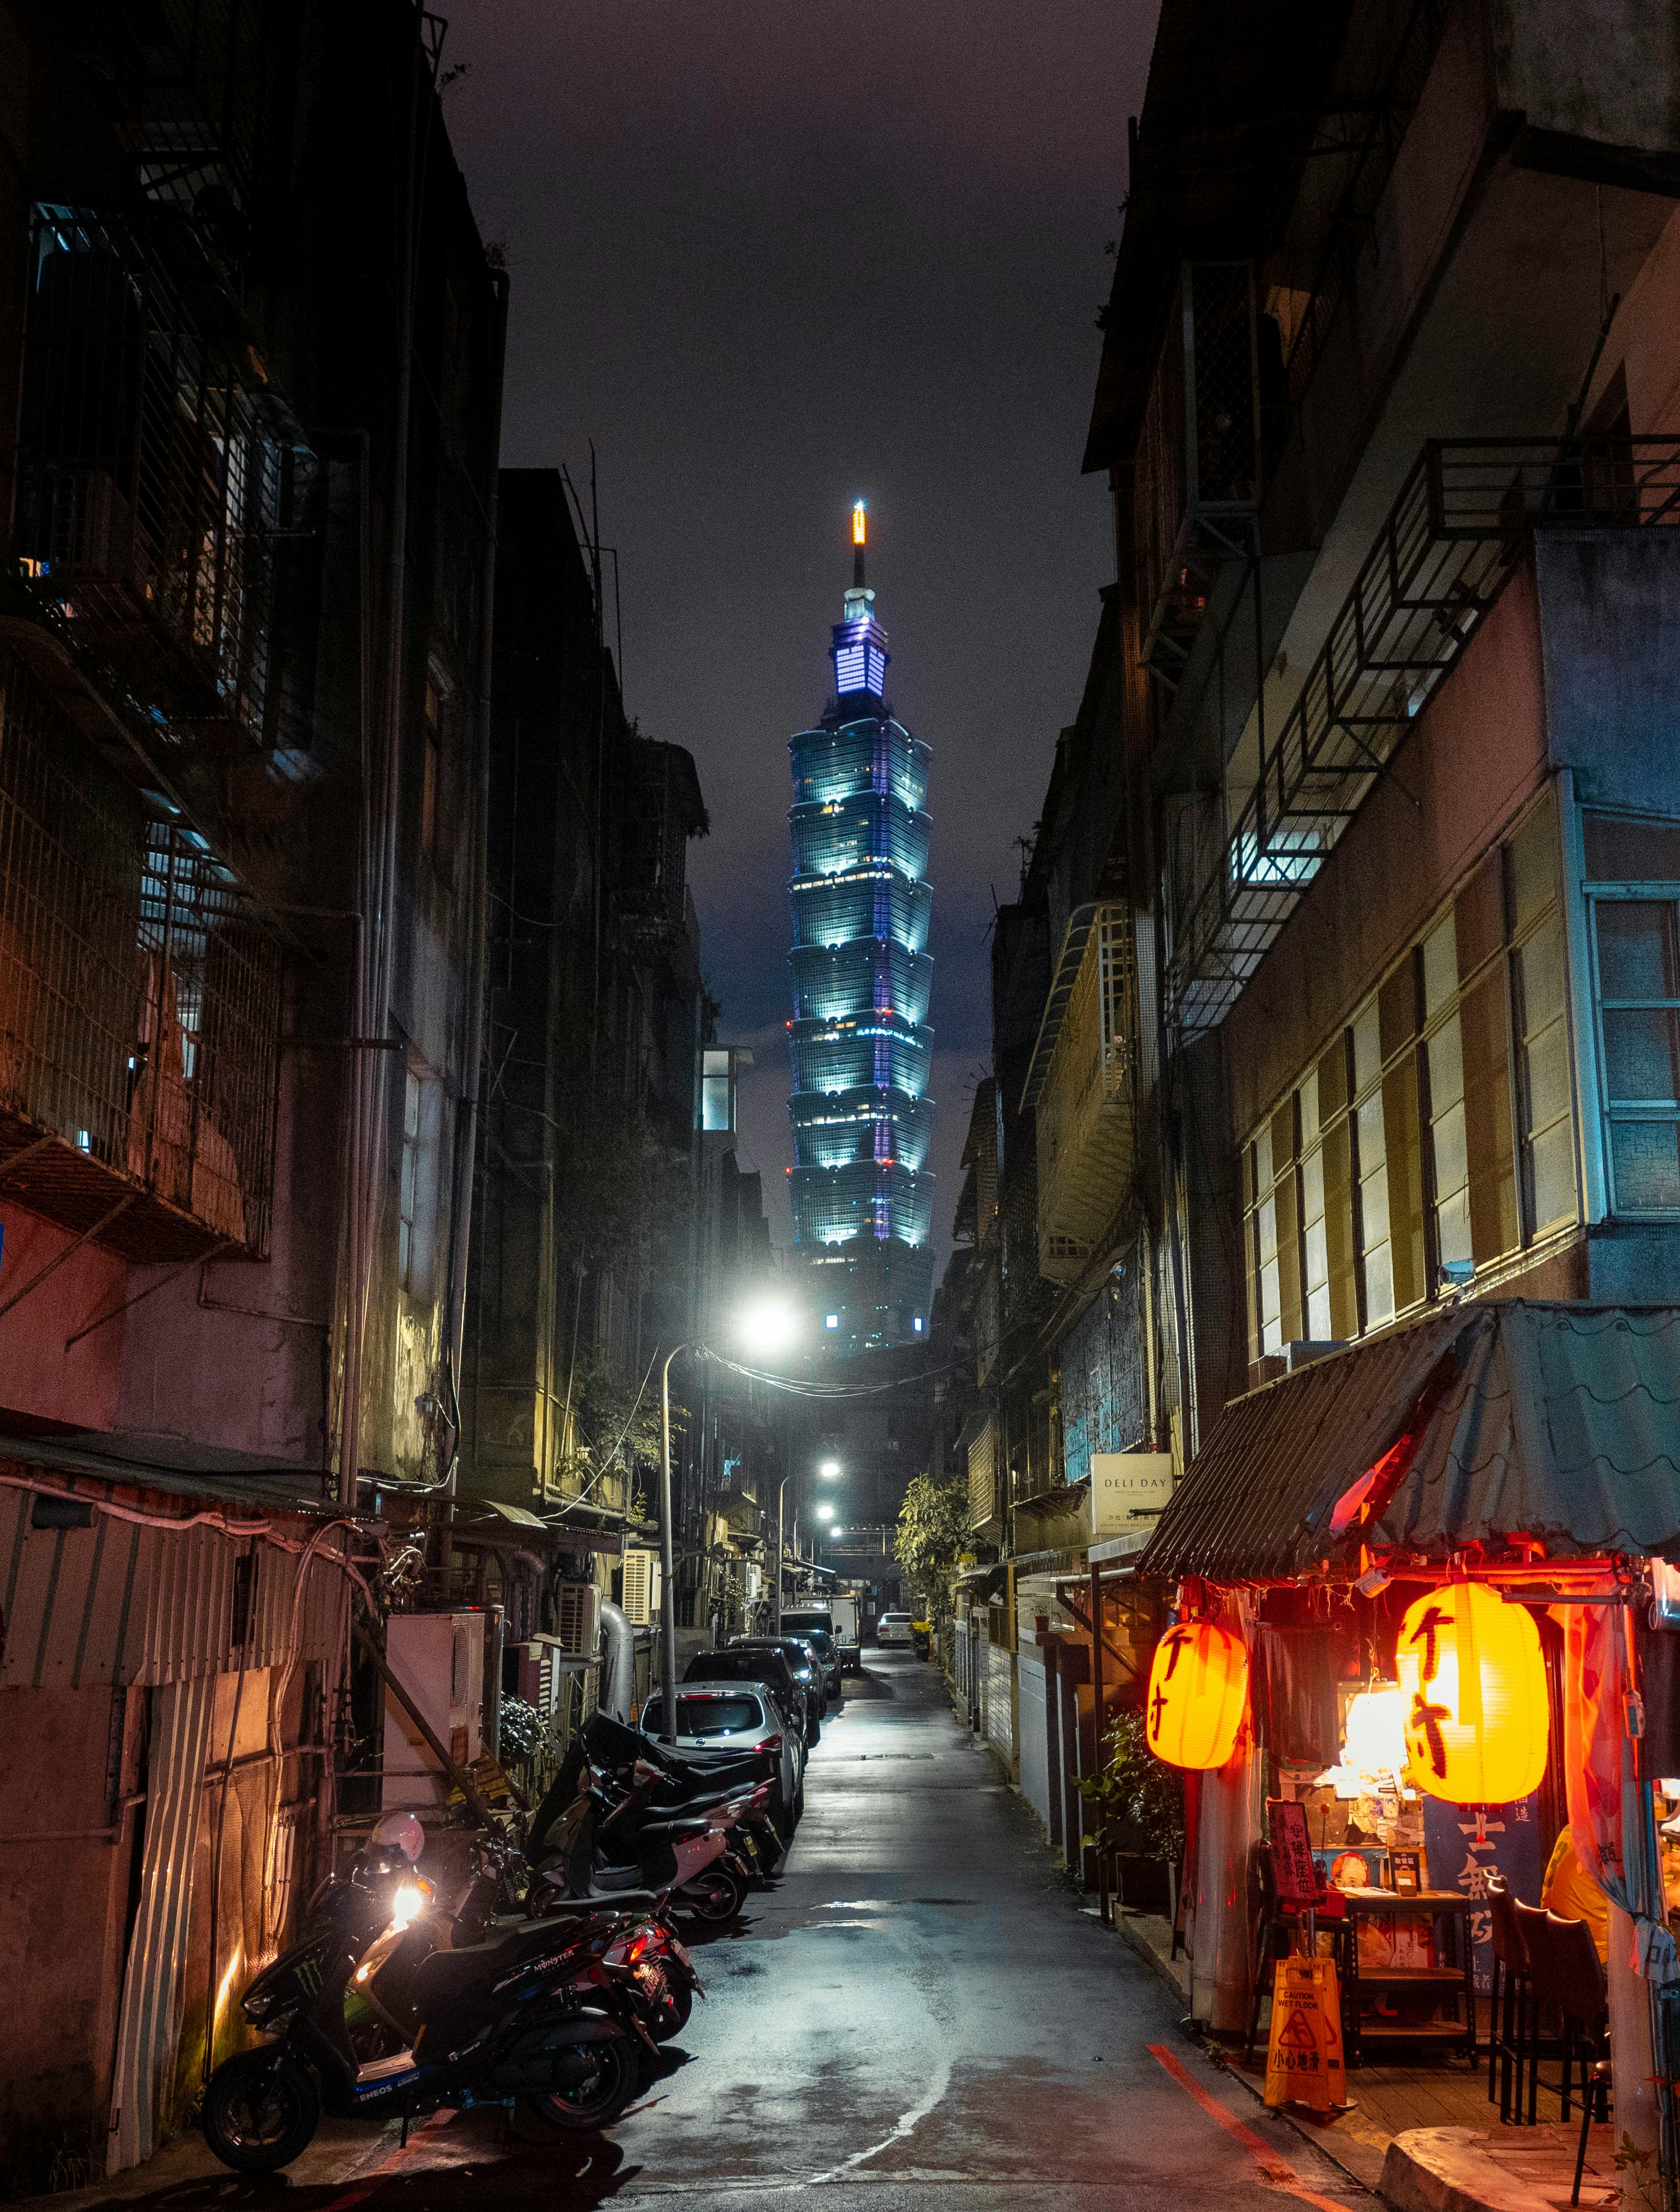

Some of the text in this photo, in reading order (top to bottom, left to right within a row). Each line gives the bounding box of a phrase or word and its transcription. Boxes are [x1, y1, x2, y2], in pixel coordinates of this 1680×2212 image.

[534, 1949, 575, 1972] MONSTER
[1278, 1999, 1318, 2009] WET FLOOR
[1283, 1991, 1314, 2000] CAUTION
[1274, 2049, 1320, 2071] 小心地滑
[360, 2084, 393, 2102] ENEOS
